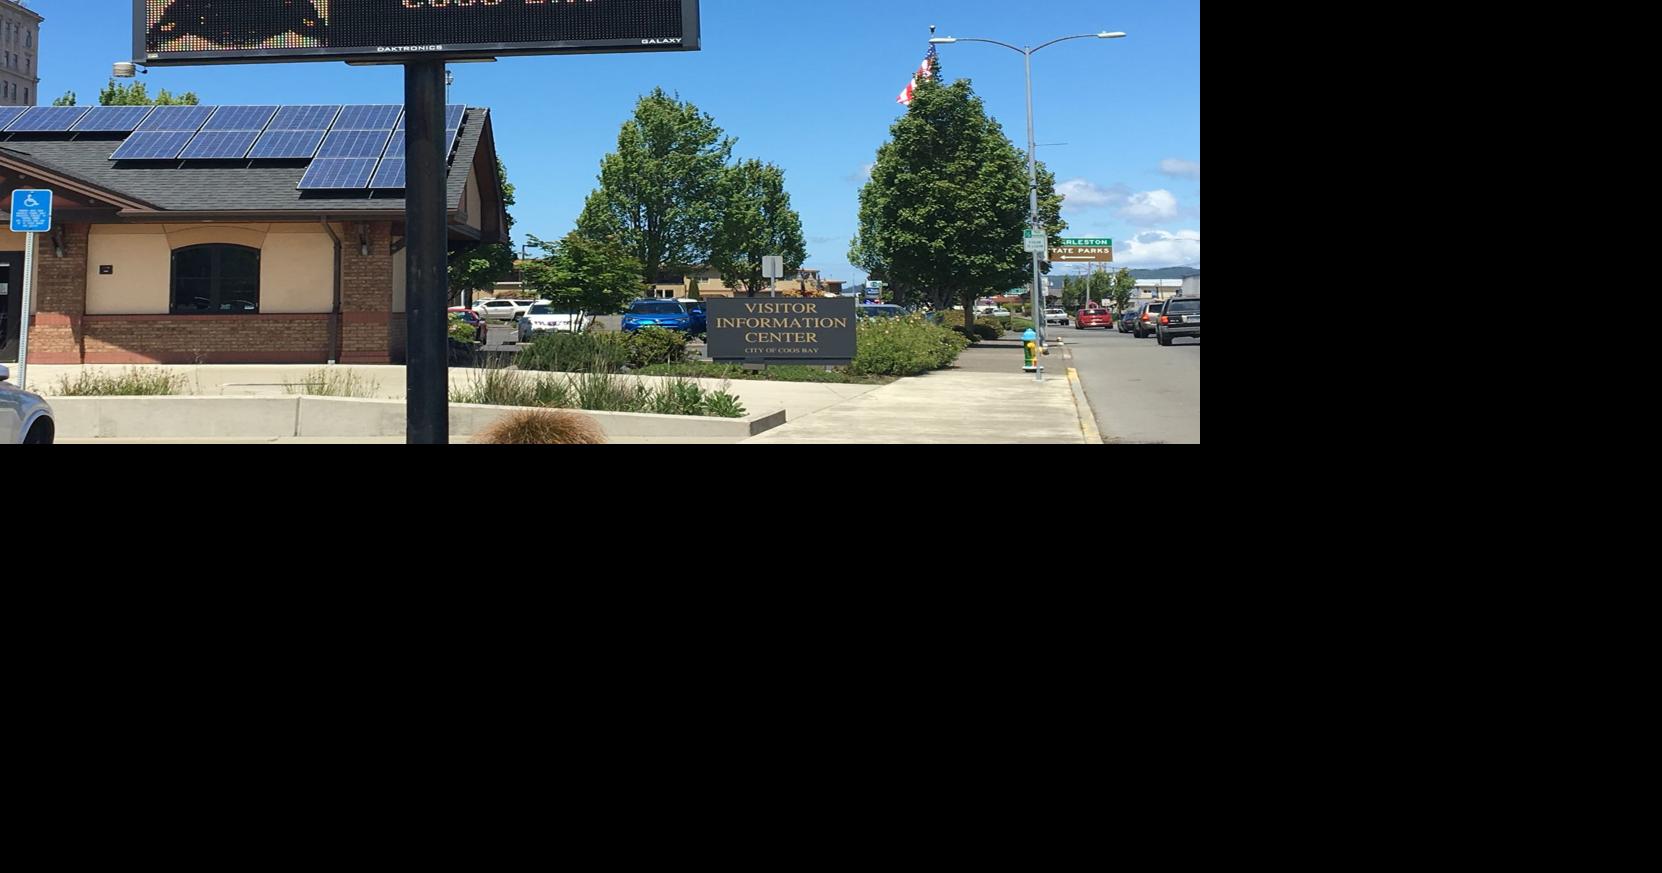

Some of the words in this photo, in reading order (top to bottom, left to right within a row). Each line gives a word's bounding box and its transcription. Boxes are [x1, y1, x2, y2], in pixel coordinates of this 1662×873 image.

[377, 44, 443, 52] DAKTRONICS
[744, 302, 818, 314] VISITOR
[715, 316, 847, 329] INFORMATION
[744, 331, 818, 343] CENTER
